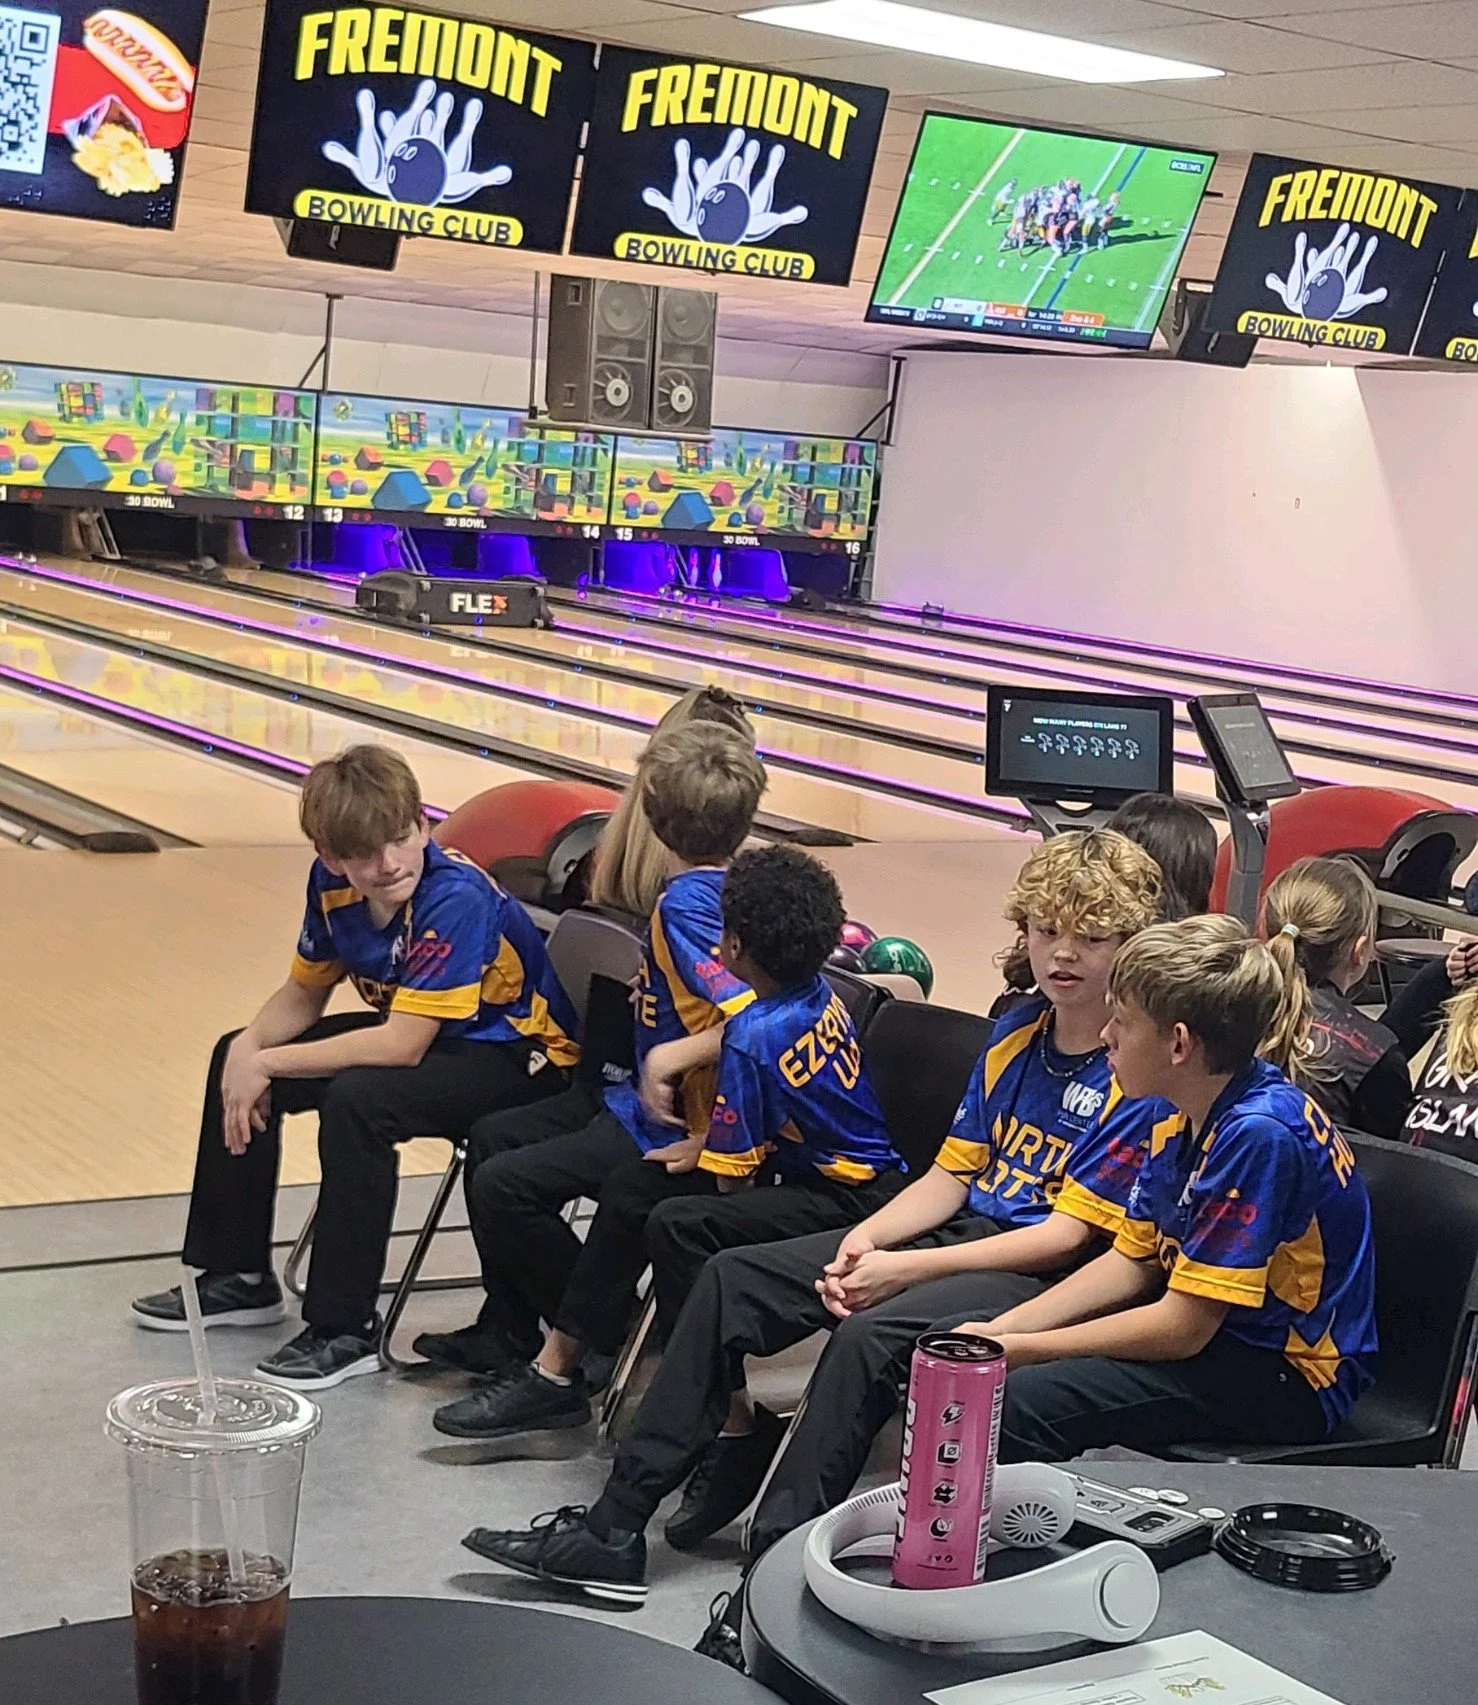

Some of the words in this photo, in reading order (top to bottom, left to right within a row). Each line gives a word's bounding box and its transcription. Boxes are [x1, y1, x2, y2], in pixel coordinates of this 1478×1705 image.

[295, 8, 562, 117] FREMONT
[621, 64, 858, 160] FREMONT
[1258, 169, 1438, 249] FREMONT
[307, 195, 436, 236] BOWLING
[442, 214, 512, 244] CLUB
[625, 237, 737, 272] BOWLING
[743, 251, 805, 278] CLUB
[1244, 315, 1329, 342] BOWLING
[1332, 325, 1380, 349] CLUB
[142, 496, 175, 508] BOWL
[282, 506, 305, 520] 12
[321, 509, 343, 522] 13
[459, 518, 487, 529] BOWL
[581, 525, 600, 539] 14
[615, 528, 633, 541] 15
[723, 535, 734, 545] 30
[735, 535, 760, 547] BOWL
[845, 542, 861, 554] 16
[450, 592, 509, 615] FLEX
